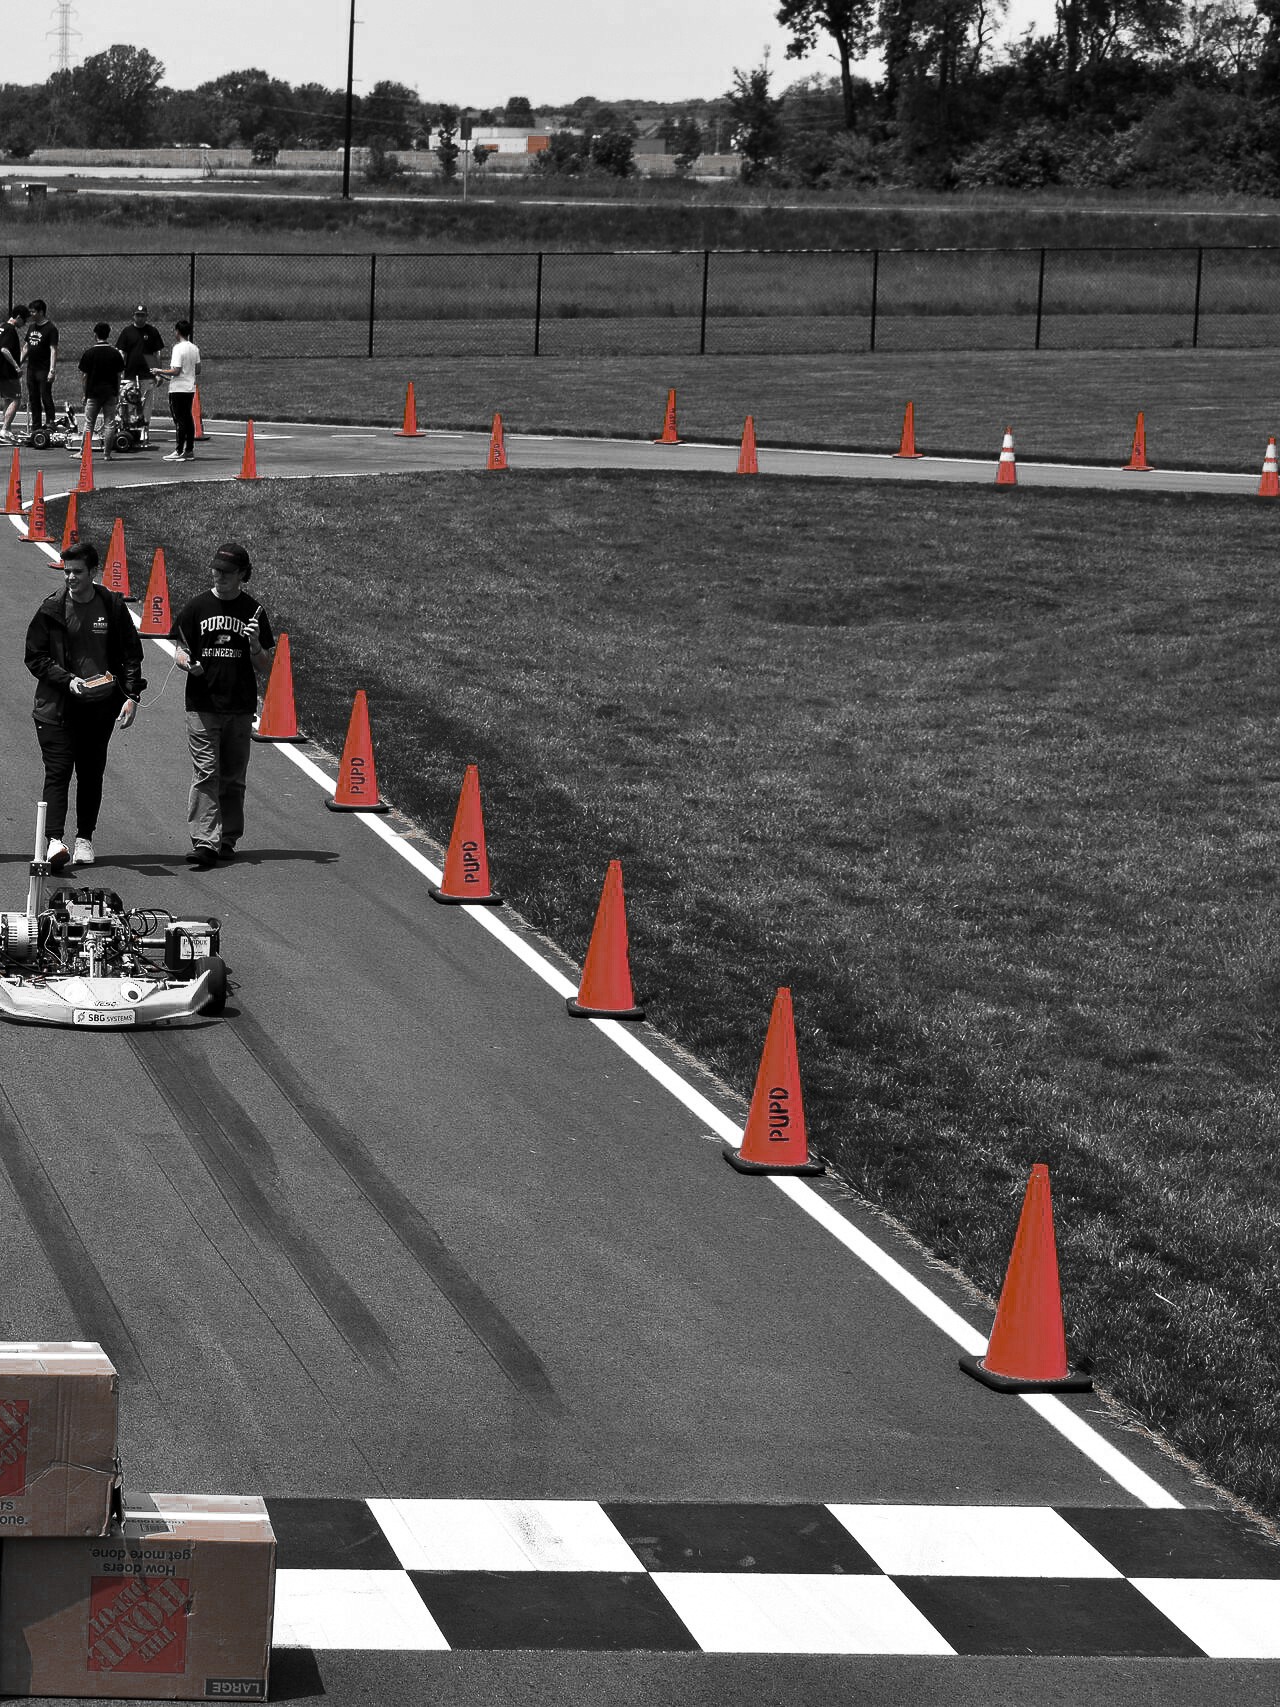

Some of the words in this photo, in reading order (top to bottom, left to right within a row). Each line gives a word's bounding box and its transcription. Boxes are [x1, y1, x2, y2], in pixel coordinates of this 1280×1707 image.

[113, 561, 122, 587] PUPD
[152, 595, 163, 624] PUPD
[200, 615, 247, 637] PURDUE
[350, 757, 365, 794] PUPD
[463, 841, 480, 883] PUPD
[88, 1013, 106, 1022] SBG
[106, 1014, 133, 1022] SYSTEMS
[769, 1087, 789, 1142] PUPD
[89, 1548, 127, 1560] done.
[130, 1549, 165, 1559] more
[167, 1549, 192, 1562] get
[103, 1562, 142, 1575] doers
[145, 1563, 177, 1576] How
[89, 1579, 151, 1636] DEPOT
[88, 1579, 189, 1672] HOME
[136, 1626, 177, 1663] THE
[211, 1681, 261, 1694] LARGE
